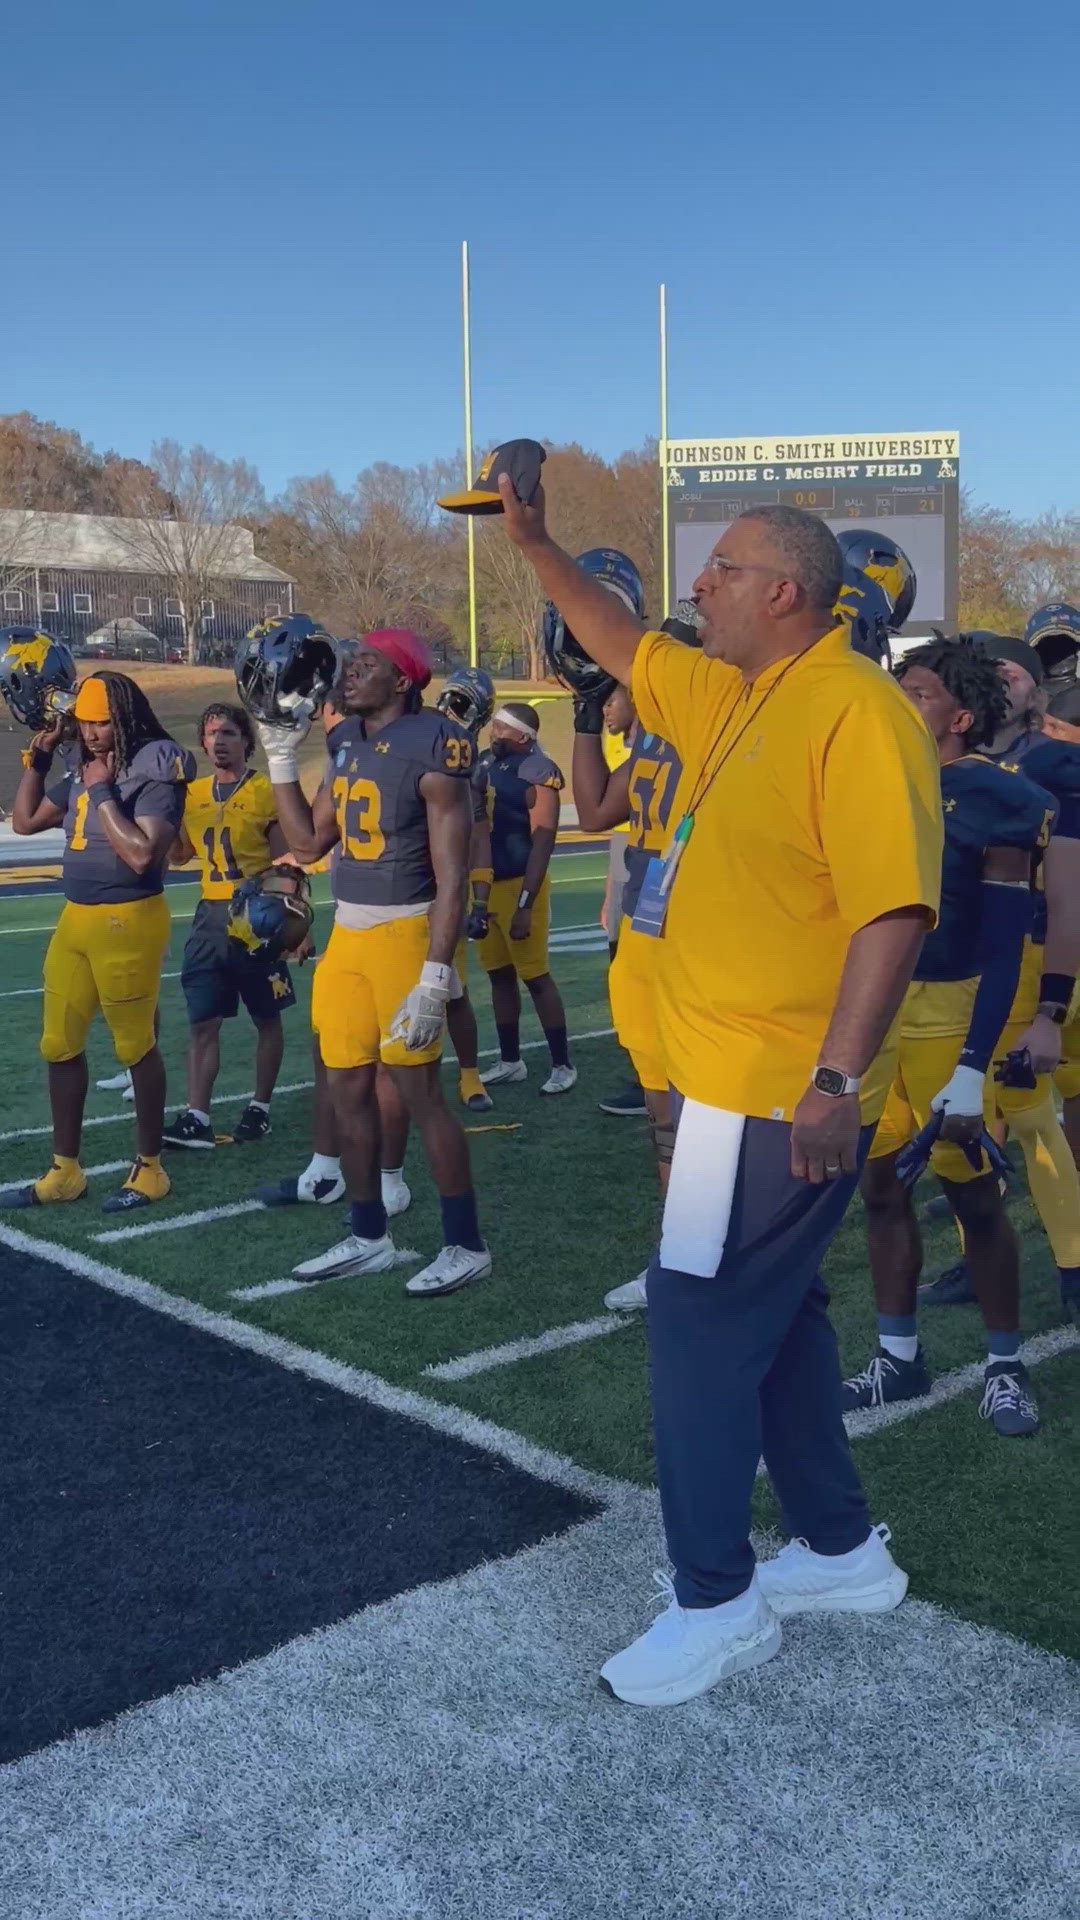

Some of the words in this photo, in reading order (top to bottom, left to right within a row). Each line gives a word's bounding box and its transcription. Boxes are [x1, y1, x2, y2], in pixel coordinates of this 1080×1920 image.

[667, 445, 746, 463] JOHNSON
[753, 445, 768, 460] C.
[775, 442, 835, 459] SMITH
[842, 438, 956, 457] UNIVERSITY
[699, 469, 757, 483] EDDIE
[762, 468, 780, 481] C.
[785, 464, 859, 480] McGIRT
[865, 463, 922, 477] FIELD
[174, 756, 186, 780] 1
[445, 738, 473, 769] 33
[628, 757, 673, 850] 51
[70, 789, 90, 851] 1
[203, 826, 244, 882] 11
